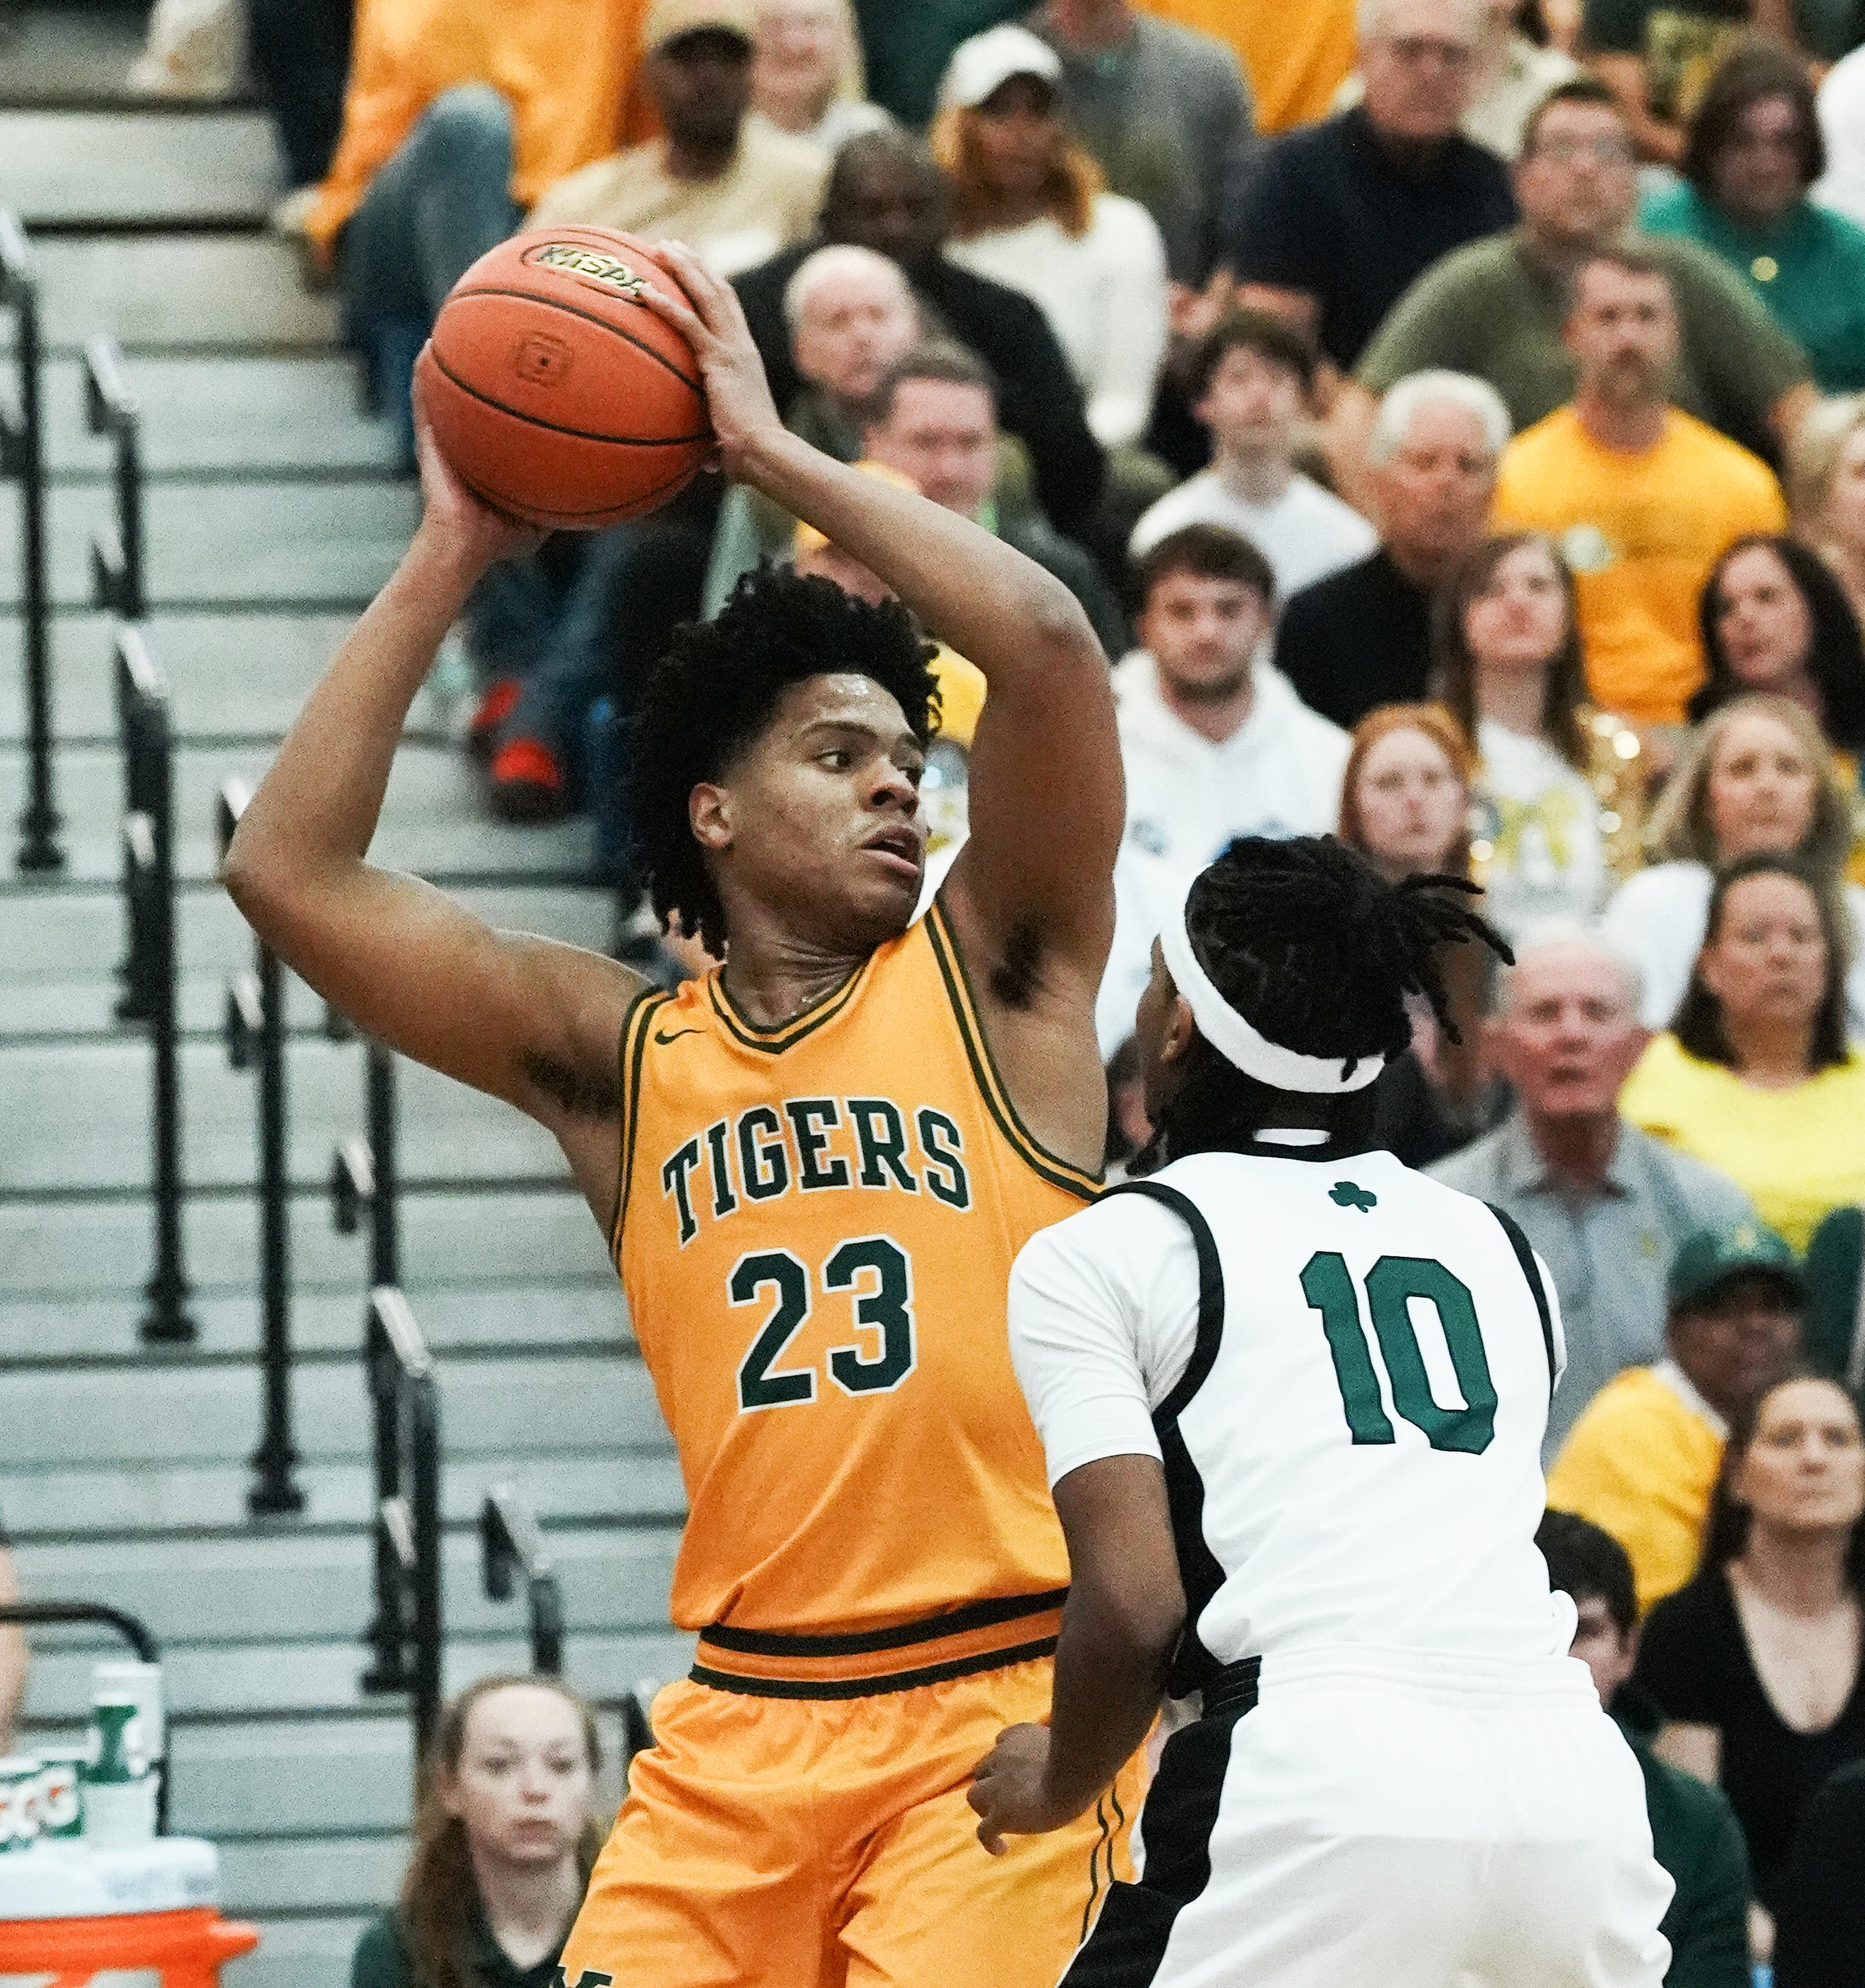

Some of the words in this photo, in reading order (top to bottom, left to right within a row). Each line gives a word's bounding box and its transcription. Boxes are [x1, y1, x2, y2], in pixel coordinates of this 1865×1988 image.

[661, 1096, 974, 1250] TIGERS
[727, 1234, 918, 1414] 23
[1299, 1251, 1498, 1455] 10
